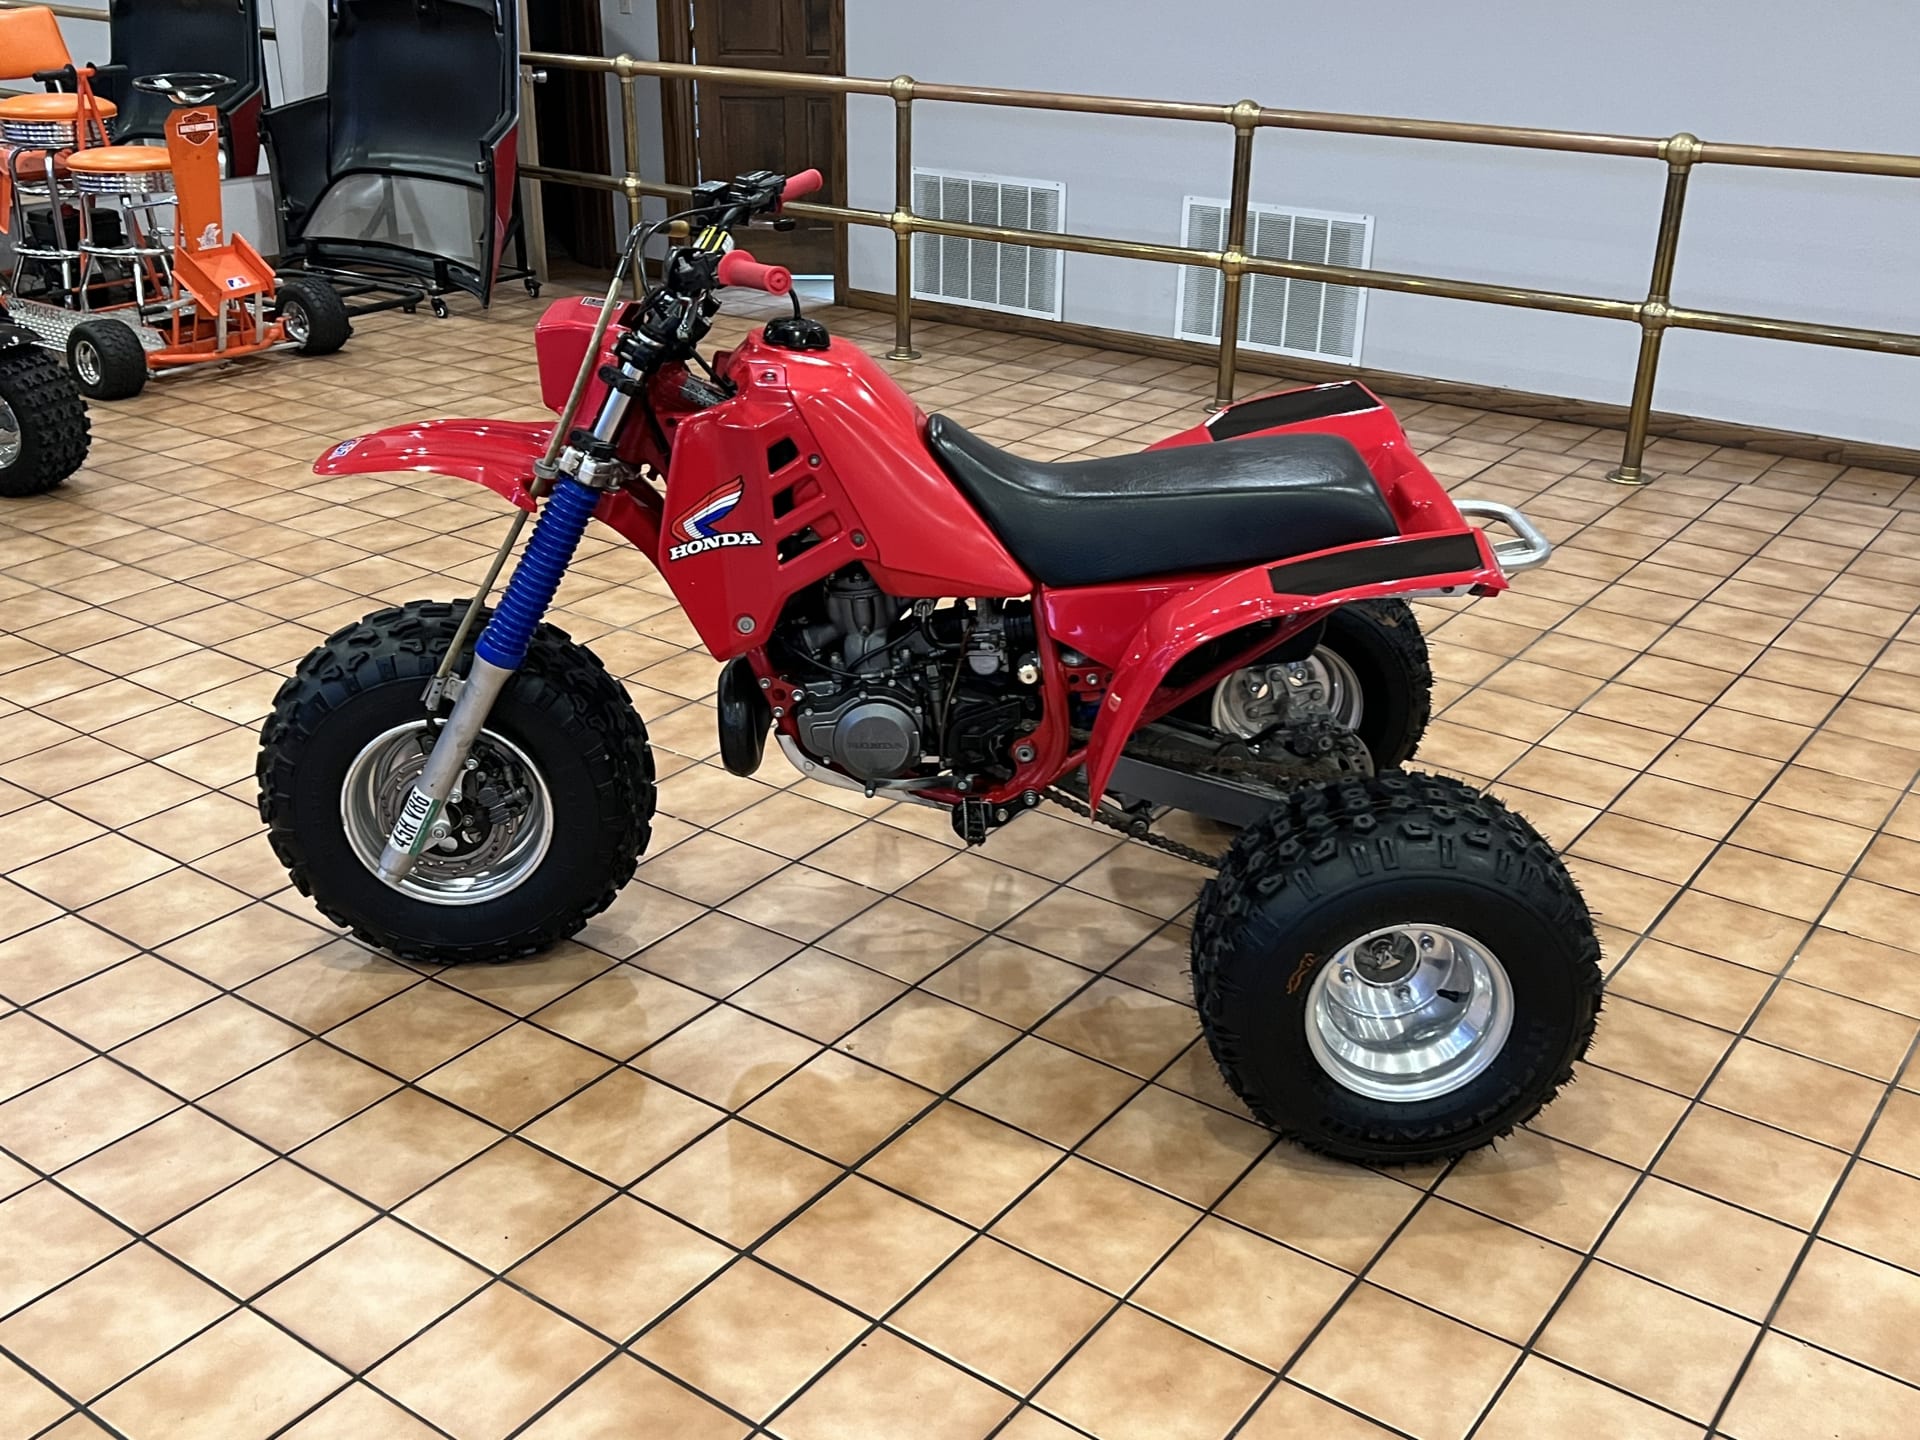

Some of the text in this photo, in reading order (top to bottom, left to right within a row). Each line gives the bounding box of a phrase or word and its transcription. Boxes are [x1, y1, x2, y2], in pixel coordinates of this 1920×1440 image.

[669, 532, 761, 560] HONDA
[404, 791, 430, 821] V86
[393, 816, 418, 848] 45H
